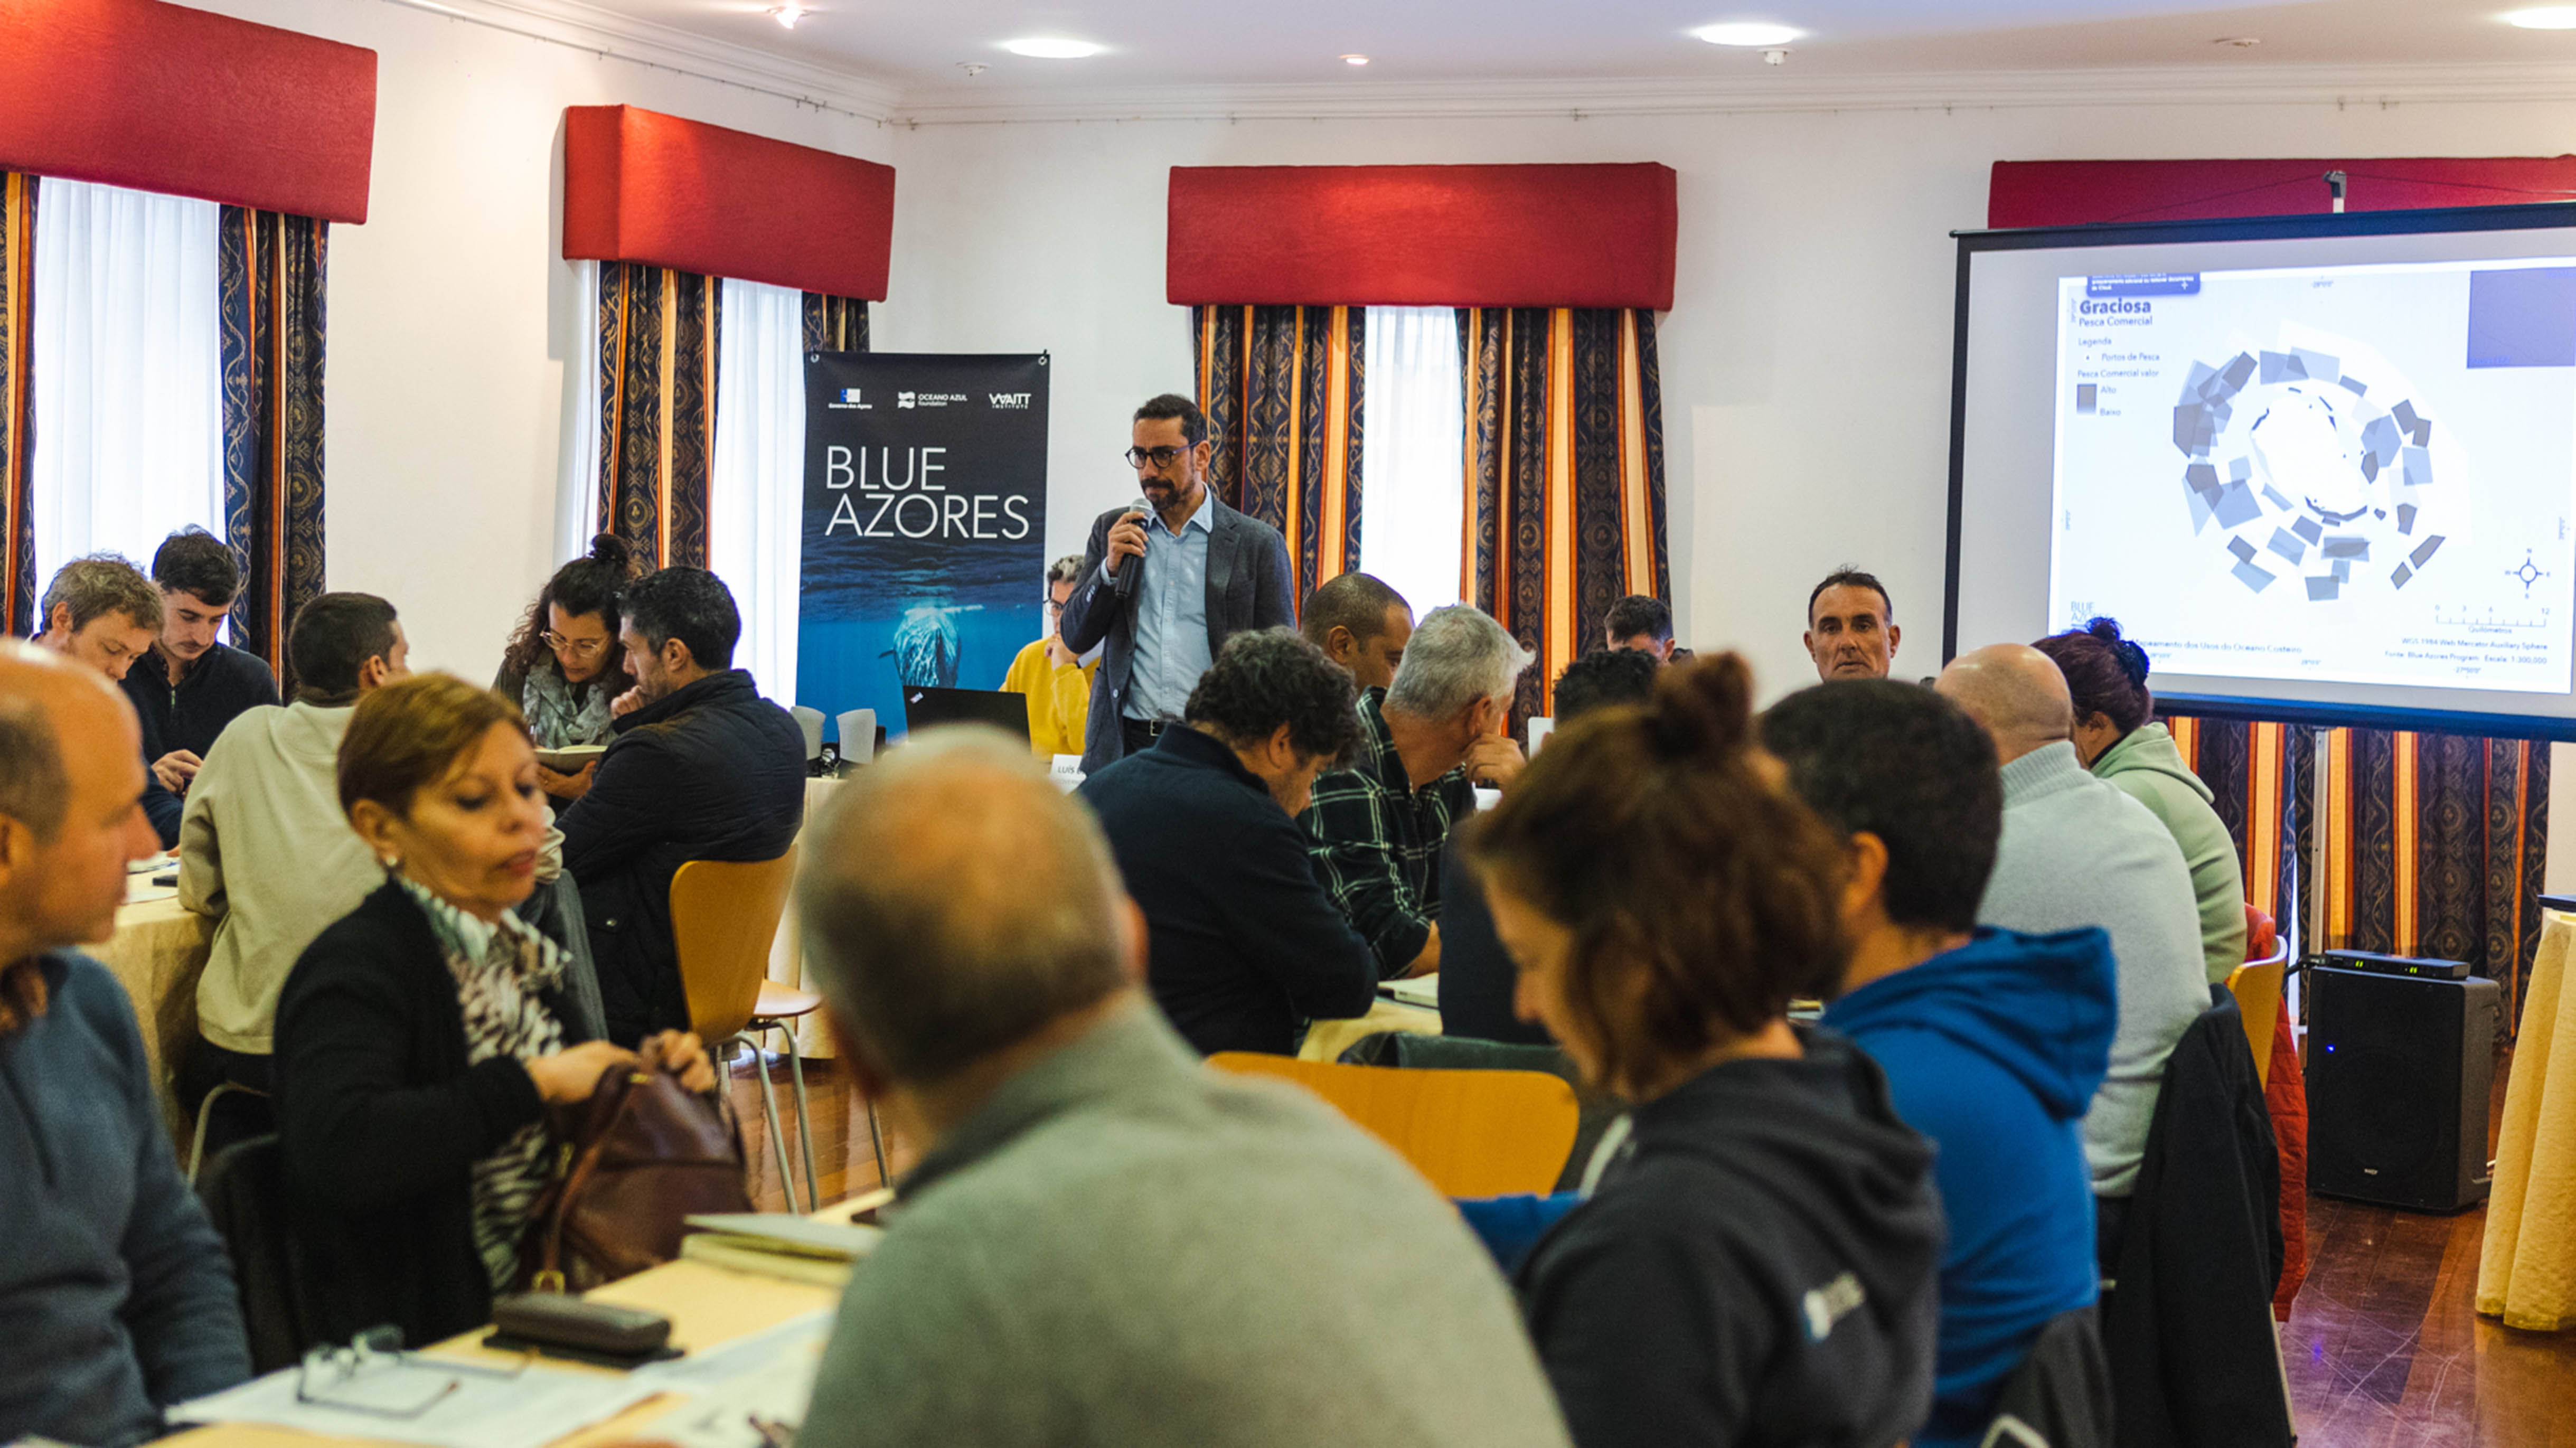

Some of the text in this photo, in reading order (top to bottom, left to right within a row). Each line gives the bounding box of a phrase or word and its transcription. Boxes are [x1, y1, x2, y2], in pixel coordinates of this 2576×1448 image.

[2080, 296, 2151, 315] Graciosa
[2079, 315, 2153, 327] Pesca Comercial
[2079, 337, 2112, 348] Legenda
[2102, 352, 2160, 361] Portos de Pesca
[2077, 369, 2099, 378] Pesca
[2100, 369, 2139, 378] Comercial
[2100, 385, 2117, 394] Alto
[989, 392, 1031, 405] WAITT
[2099, 408, 2121, 416] Baixo
[826, 446, 946, 491] BLUE
[825, 493, 1030, 540] AZORES
[2184, 641, 2198, 650] dos
[2200, 642, 2220, 651] Usos
[2221, 642, 2232, 651] do
[2234, 643, 2265, 652] Oceano
[2267, 645, 2302, 654] Costeiro
[2490, 642, 2520, 650] Auxiliary
[2522, 642, 2548, 650] Sphere
